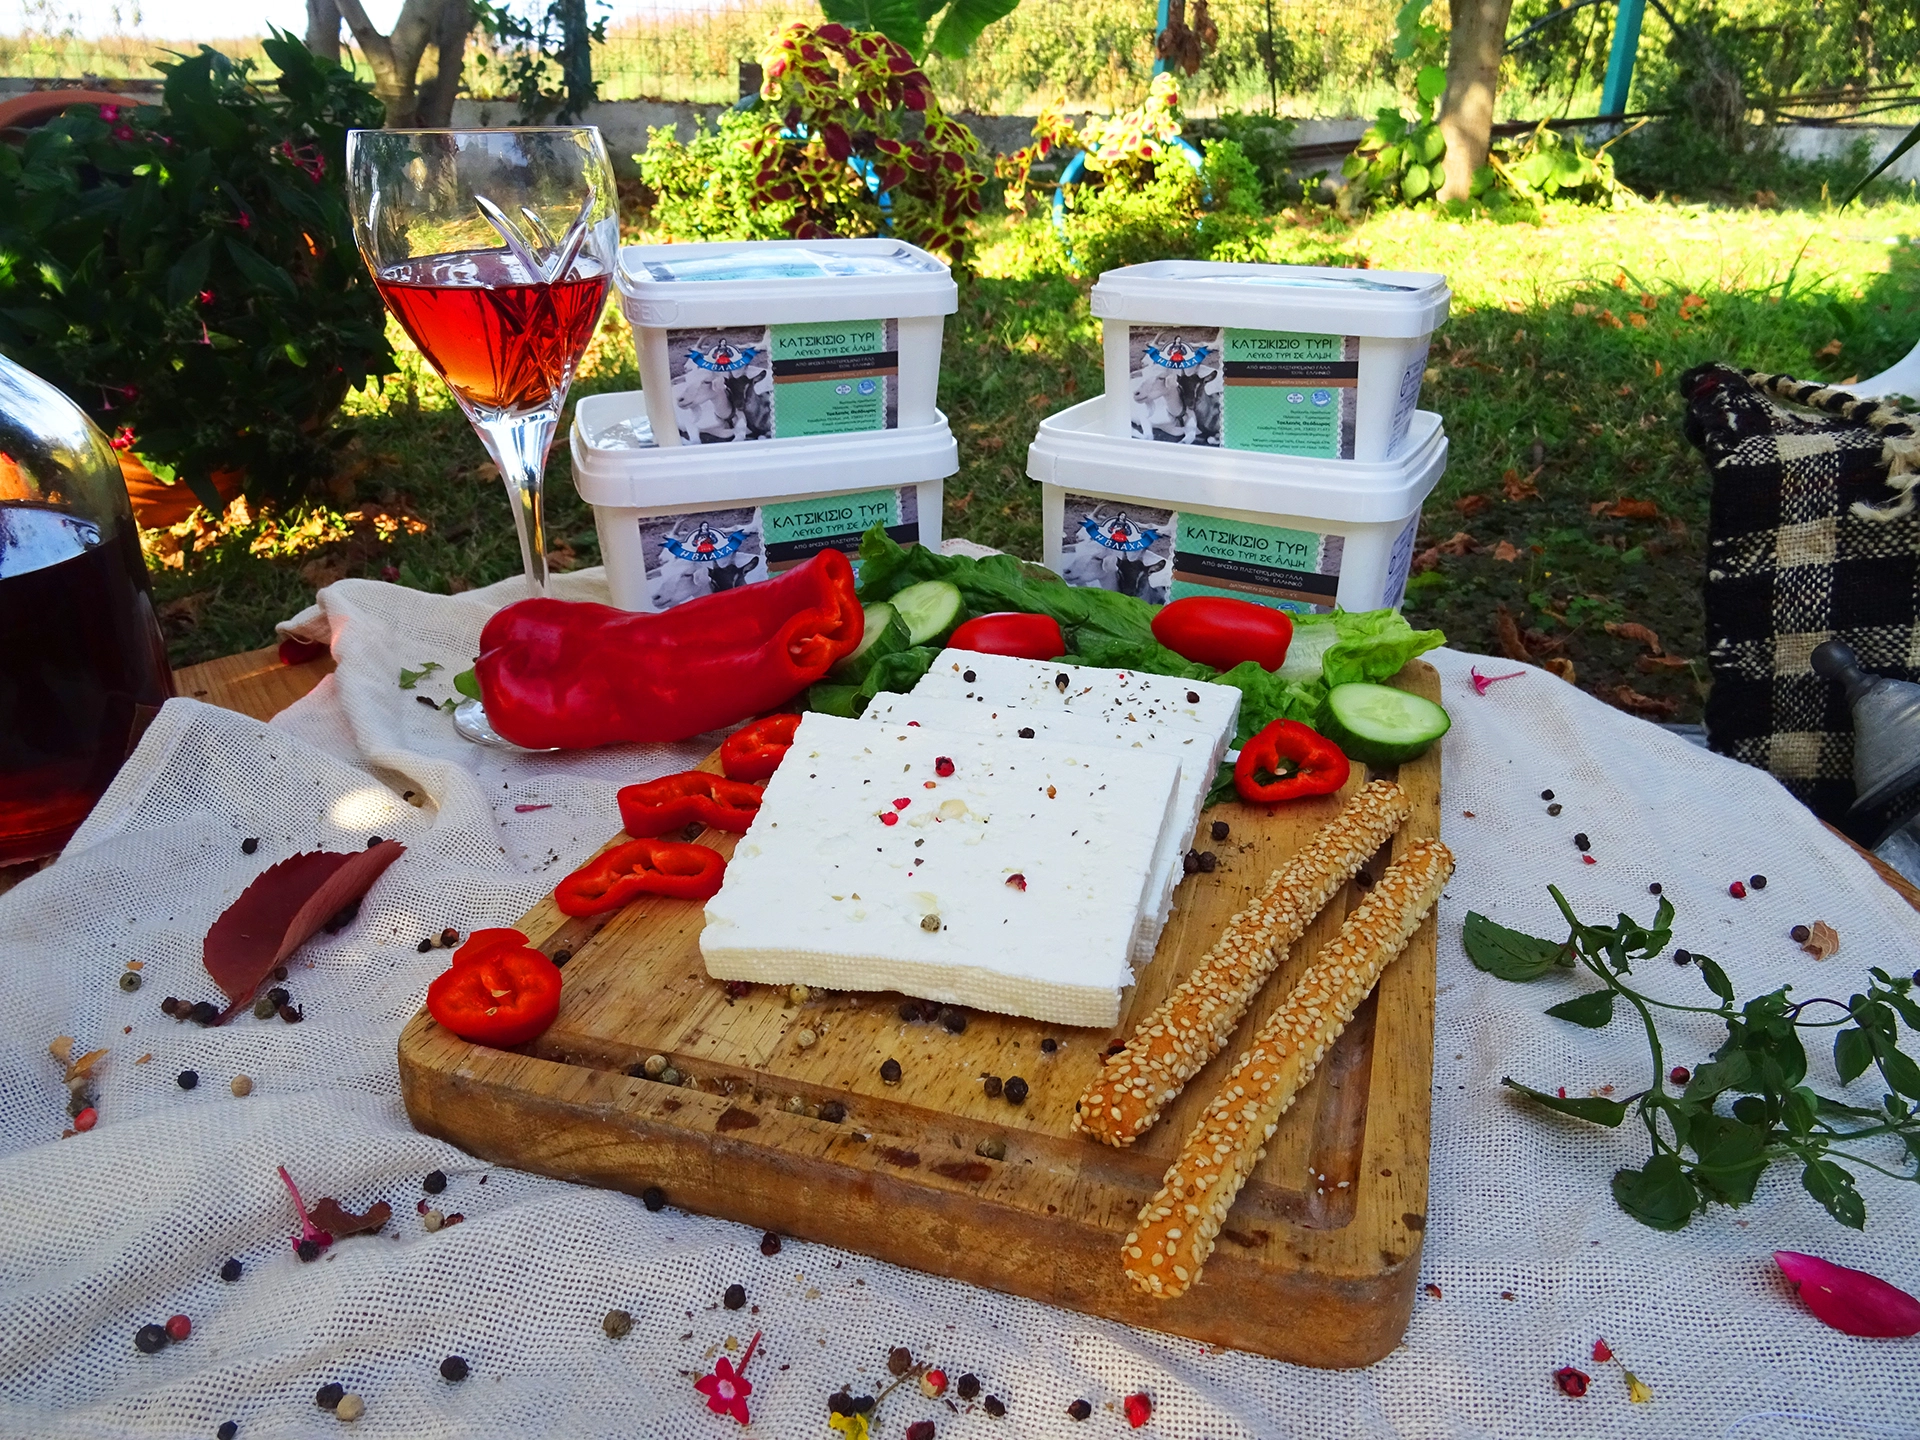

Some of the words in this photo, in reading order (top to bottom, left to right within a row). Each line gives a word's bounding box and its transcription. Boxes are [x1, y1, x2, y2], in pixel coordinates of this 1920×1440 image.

[779, 334, 846, 348] ΚΑΤΣΙΚΙΣΙΟ
[850, 332, 875, 343] ΤΥΡΙ
[1232, 338, 1301, 349] ΚΑΤΣΙΚΙΣΙΟ
[1305, 338, 1332, 349] ΤΥΡΙ
[822, 347, 838, 355] ΤΥΡΙ
[840, 346, 850, 354] ΣΕ
[773, 507, 853, 529] ΚΑΤΣΙΚΙΣΙΟ
[858, 502, 888, 517] ΤΥΡΙ
[792, 526, 823, 538] ΛΕΥΚΟ
[825, 524, 844, 533] ΤΥΡΙ
[847, 522, 858, 530] ΣΕ
[1104, 541, 1144, 551] ΒΛΑΧΑ
[1186, 526, 1269, 550] ΚΑΤΣΙΚΙΣΙΟ
[1275, 539, 1308, 557] ΤΥΡΙ
[691, 546, 733, 561] ΒΛΑΧΑ
[1202, 545, 1234, 557] ΛΕΥΚΟ
[1237, 550, 1258, 561] ΤΥΡΙ
[1259, 554, 1272, 563] ΣΕ
